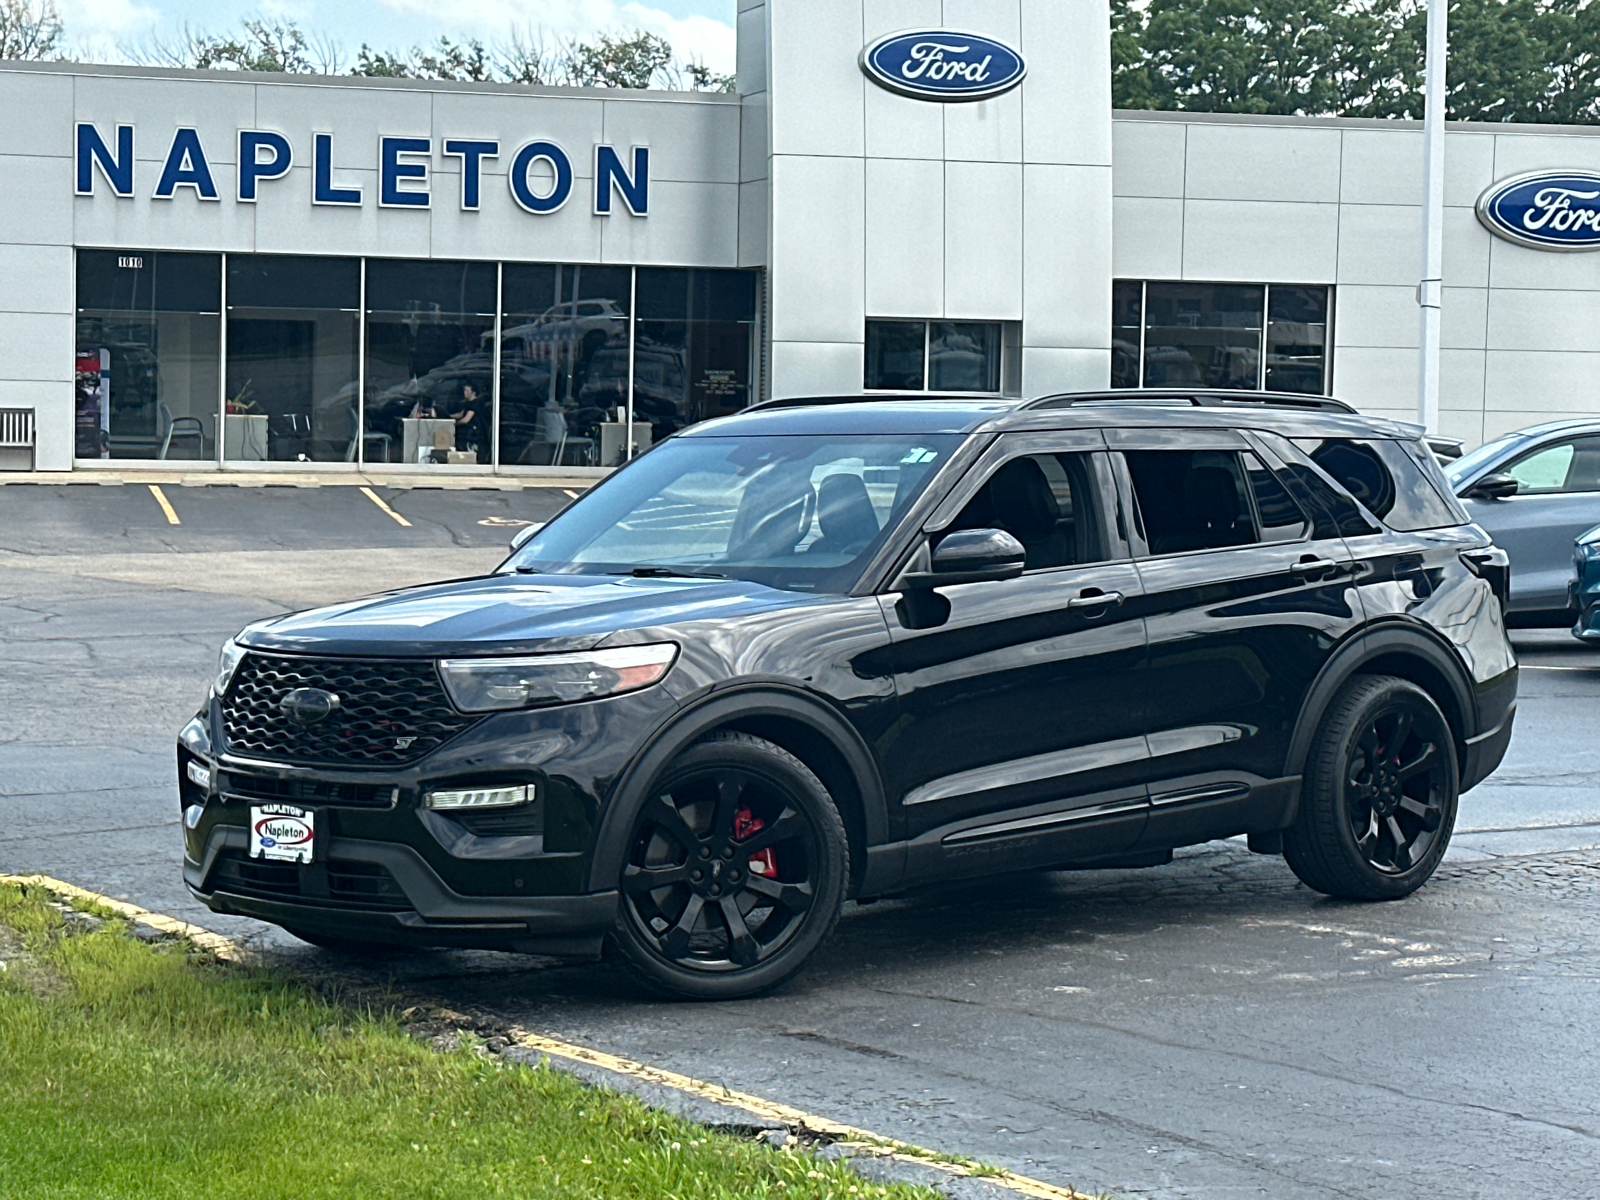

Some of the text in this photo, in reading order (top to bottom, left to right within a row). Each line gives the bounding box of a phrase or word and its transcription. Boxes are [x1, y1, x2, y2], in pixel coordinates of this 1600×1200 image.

[901, 42, 992, 82] Ford
[74, 121, 650, 217] NAPLETON
[119, 256, 142, 268] 1010
[265, 822, 304, 839] Napleton
